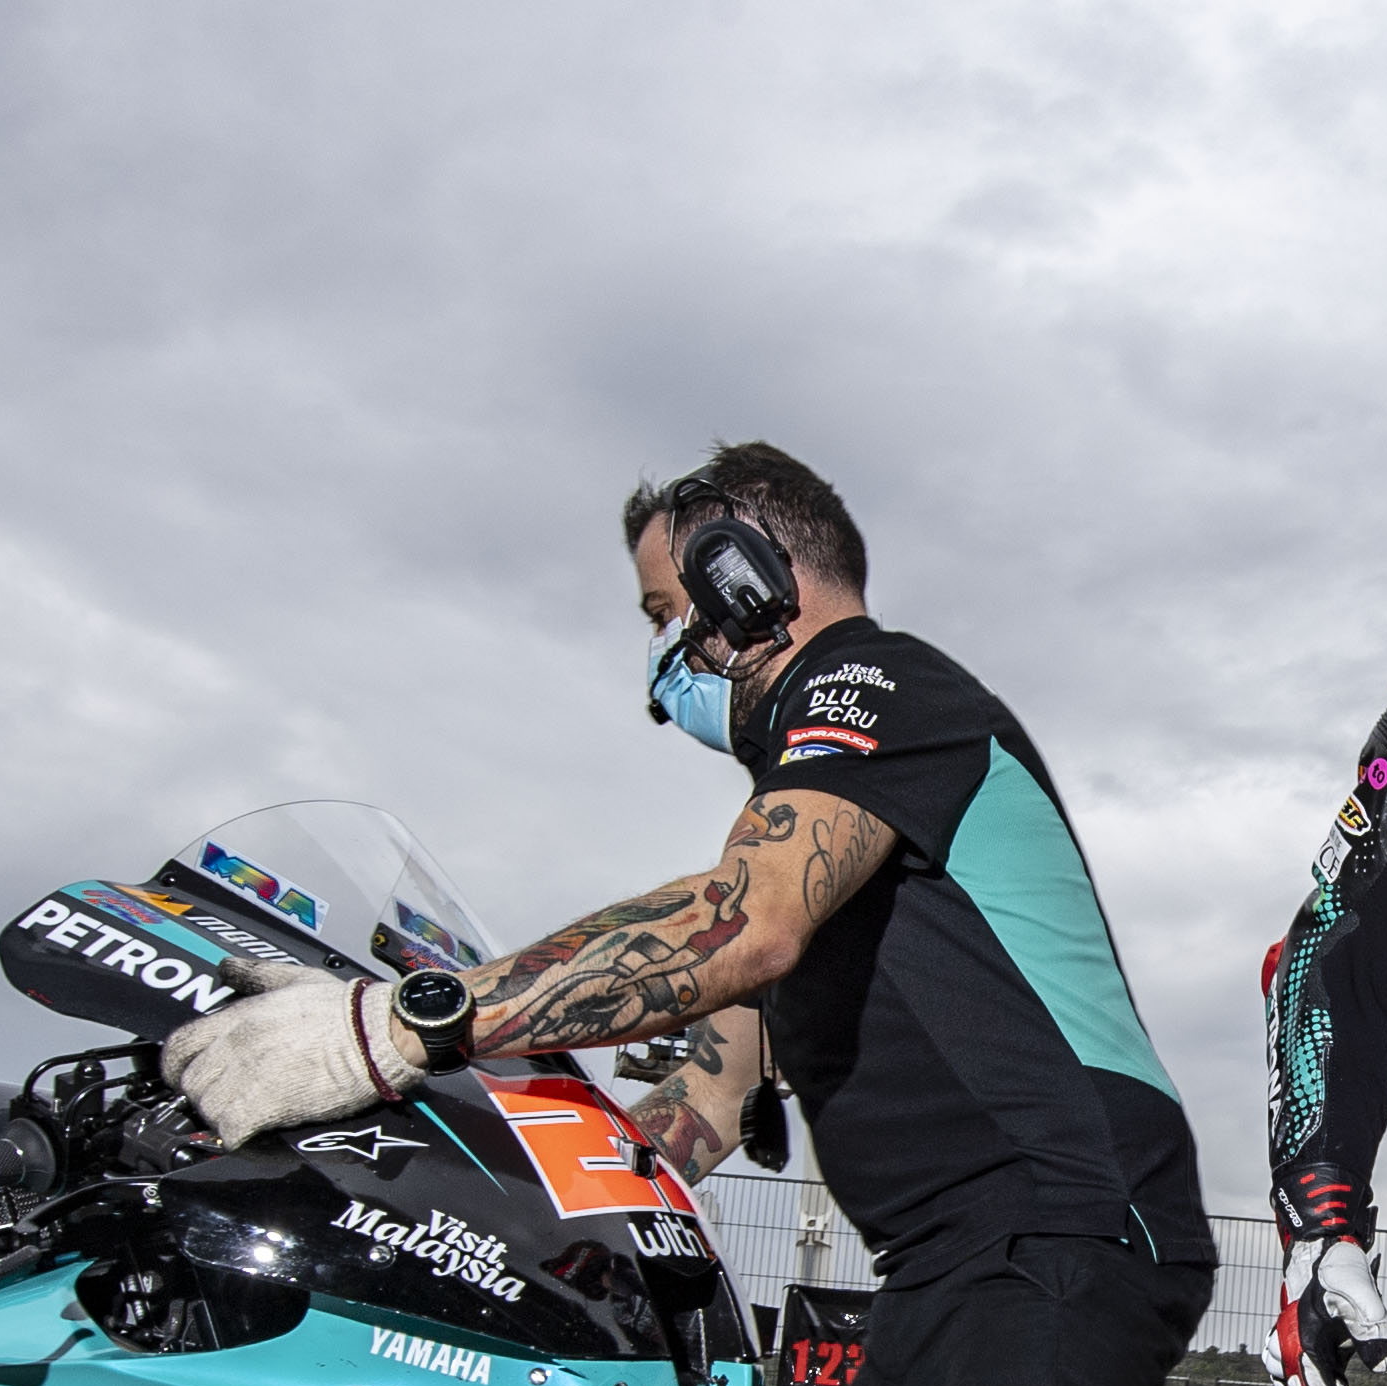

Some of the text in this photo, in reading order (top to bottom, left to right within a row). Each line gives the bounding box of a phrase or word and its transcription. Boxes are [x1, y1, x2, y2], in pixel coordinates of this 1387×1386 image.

[803, 669, 896, 692] Malaysia
[842, 663, 884, 677] Visit
[790, 729, 875, 751] BARRACUDA
[200, 840, 318, 931] MRA
[17, 898, 237, 1016] PETRON
[330, 1199, 527, 1303] Malaysia
[423, 1208, 509, 1264] Visit
[369, 1325, 493, 1386] YAMAHA
